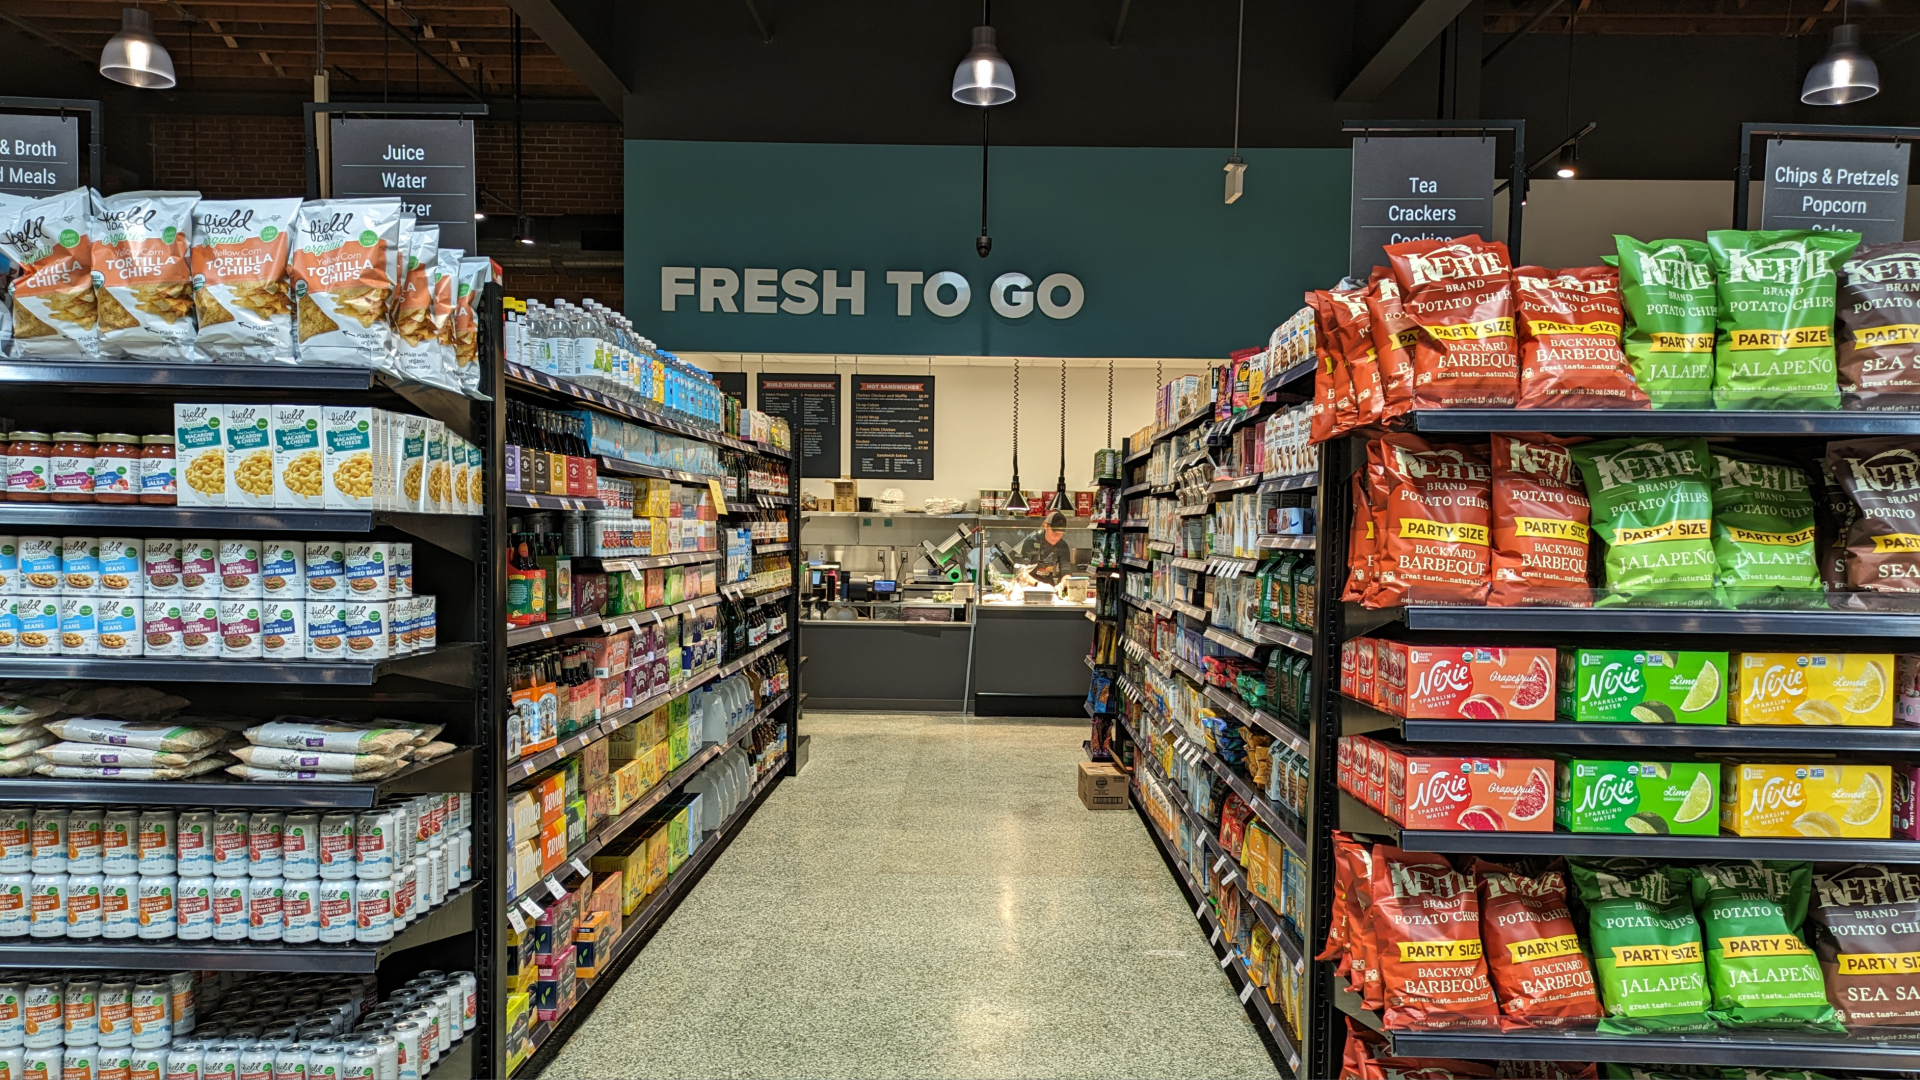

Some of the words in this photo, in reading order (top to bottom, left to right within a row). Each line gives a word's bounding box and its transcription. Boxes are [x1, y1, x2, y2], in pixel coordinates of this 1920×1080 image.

[0, 139, 10, 155] &
[15, 140, 57, 157] Broth
[383, 144, 425, 160] Juice
[9, 167, 56, 184] Meals
[382, 172, 427, 188] Water
[1775, 166, 1817, 187] Chips
[1822, 168, 1832, 184] &
[1837, 168, 1899, 186] Pretzels
[1409, 177, 1437, 193] Tea
[401, 201, 431, 216] tzer
[1388, 204, 1457, 221] Crackers
[1802, 196, 1867, 216] Popcorn
[197, 209, 254, 234] field
[317, 233, 335, 242] DAY
[212, 248, 240, 257] Yellow
[241, 247, 262, 256] Corn
[317, 256, 340, 266] Yellow
[341, 252, 362, 261] Corn
[106, 256, 176, 270] TORTILLA
[206, 253, 274, 270] TORTILLA
[307, 259, 374, 277] TORTILLA
[1402, 244, 1511, 287] KETTLE
[1724, 240, 1836, 284] KETTLE
[119, 266, 162, 279] CHIPS
[217, 266, 261, 277] CHIPS
[320, 272, 360, 285] CHIPS
[26, 273, 71, 289] CHIPS
[1445, 279, 1485, 293] BRAND
[661, 266, 865, 316] FRESH
[886, 271, 972, 318] TO
[989, 272, 1085, 319] GO
[1762, 286, 1805, 297] BRAND
[1417, 297, 1472, 314] POTATO
[1581, 303, 1620, 315] CHIPS
[1646, 304, 1686, 317] POTATO
[1688, 305, 1718, 318] CHIPS
[1730, 301, 1788, 313] POTATO
[1792, 296, 1834, 311] CHIPS
[1853, 297, 1912, 314] POTATO
[1435, 326, 1479, 337] PARTY
[1538, 322, 1585, 332] PARTY
[1590, 324, 1618, 335] SIZE
[1550, 338, 1616, 347] BACKYARD
[1738, 331, 1791, 346] PARTY
[1796, 330, 1827, 343] SIZE
[1449, 342, 1508, 352] BACKYARD
[1438, 353, 1517, 368] BARBEQUE
[1728, 356, 1833, 380] JALAPEÑO
[1862, 355, 1906, 372] SEA
[1437, 371, 1459, 379] great
[10, 477, 29, 486] SALSA
[61, 478, 82, 486] SALSA
[1426, 482, 1467, 491] BRAND
[1637, 479, 1679, 494] BRAND
[1456, 495, 1490, 510] CHIPS
[1669, 491, 1709, 507] CHIPS
[1407, 522, 1454, 538] PARTY
[1458, 527, 1484, 541] SIZE
[1524, 521, 1567, 536] PARTY
[1570, 524, 1586, 540] SIZE
[1736, 530, 1782, 544] PARTY
[1785, 529, 1817, 544] SIZE
[1415, 544, 1476, 560] BACKYARD
[33, 563, 56, 571] BEANS
[105, 565, 126, 573] BEANS
[1399, 555, 1487, 577] BARBEQUE
[1619, 548, 1716, 575] JALAPEÑO
[1399, 572, 1421, 581] great
[1878, 563, 1920, 578] SEA
[1411, 650, 1419, 664] 0
[1410, 660, 1469, 700] Nixie
[1580, 662, 1641, 702] Nixie
[1419, 693, 1457, 704] SPARKLING
[1426, 700, 1451, 709] WATER
[1487, 782, 1536, 795] Grapefruit
[1574, 773, 1635, 814] Nixie
[1663, 786, 1691, 797] Lime
[1831, 787, 1866, 800] Lemon
[1743, 776, 1802, 817] Nixie
[1417, 803, 1456, 815] SPARKLING
[1751, 809, 1791, 822] SPARKLING
[1592, 813, 1617, 823] WATER
[1760, 816, 1785, 826] WATER
[216, 837, 244, 845] SPARKLING
[220, 842, 240, 850] WATER
[140, 899, 169, 908] SPARKLING
[360, 904, 388, 913] SPARKLING
[1854, 908, 1899, 919] BRAND
[1828, 924, 1887, 936] POTATO
[1406, 944, 1455, 958] PARTY
[1458, 943, 1481, 956] SIZE
[1517, 941, 1560, 957] PARTY
[1623, 949, 1670, 963] PARTY
[1671, 945, 1699, 960] SIZE
[1533, 959, 1584, 977] BACKYARD
[1404, 974, 1490, 994] BARBEQUE
[1729, 966, 1820, 987] JALAPEÑO
[1848, 987, 1889, 1002] SEA
[28, 1007, 57, 1017] SPARKLING
[32, 1013, 52, 1022] WATER
[107, 1012, 128, 1020] WATER
